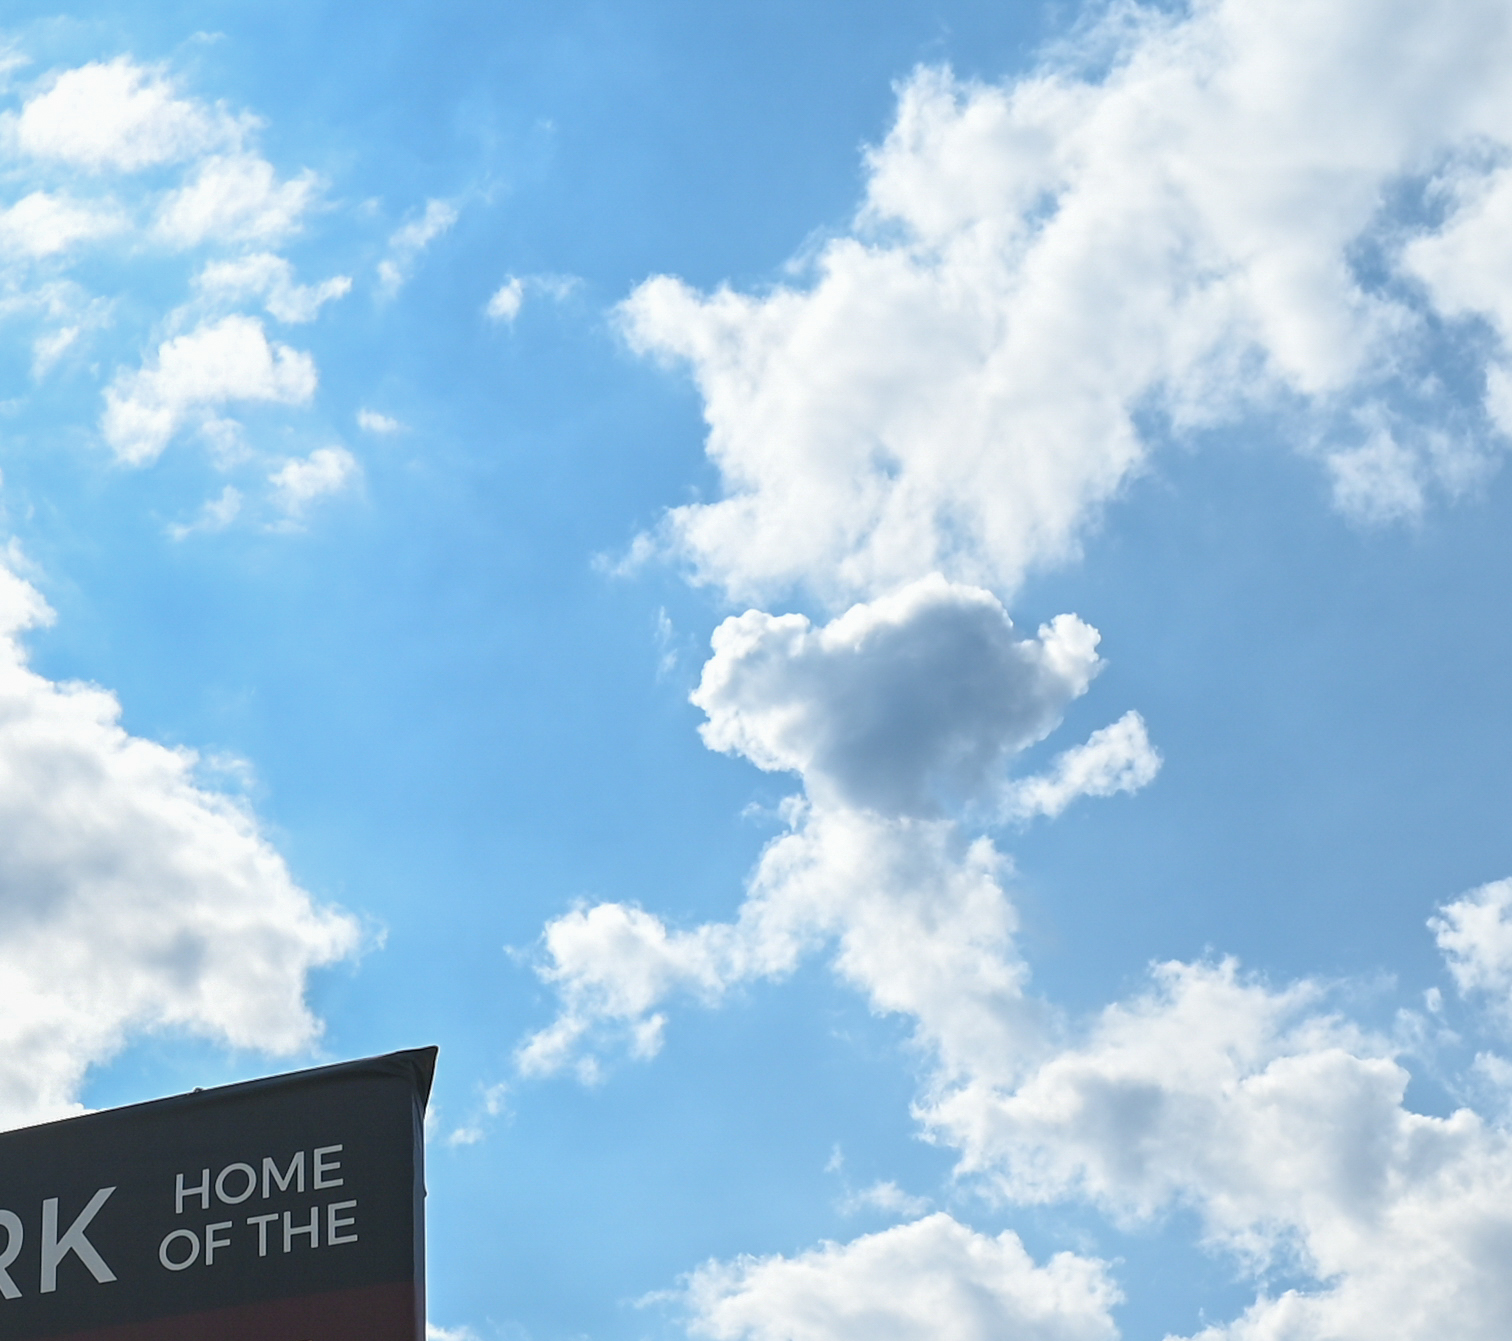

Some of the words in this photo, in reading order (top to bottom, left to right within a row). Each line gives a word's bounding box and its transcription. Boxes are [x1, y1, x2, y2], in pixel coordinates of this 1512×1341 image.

[176, 1145, 343, 1213] HOME
[160, 1221, 232, 1270] OF
[247, 1200, 357, 1256] THE
